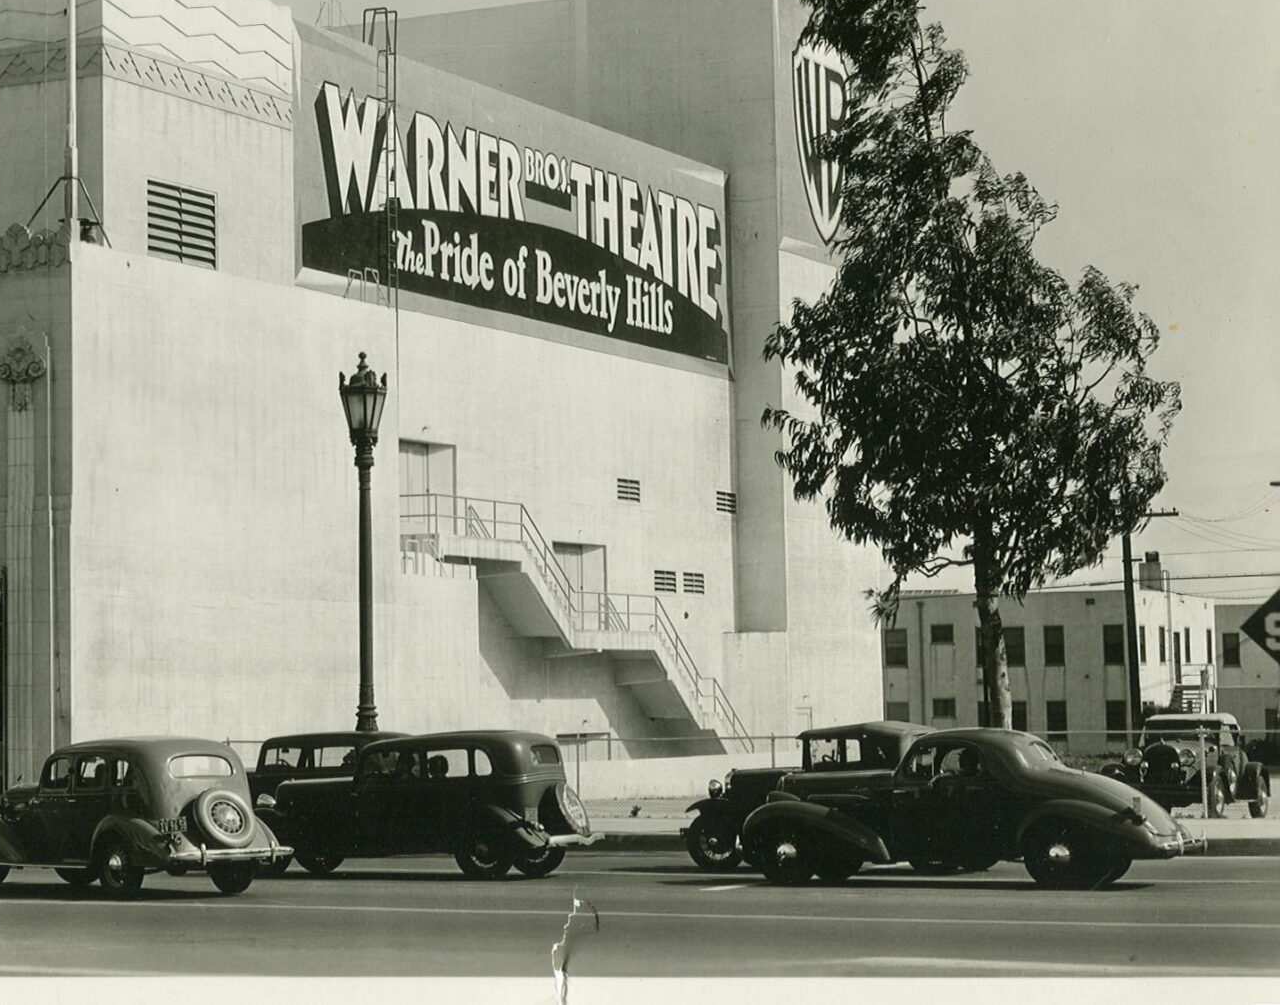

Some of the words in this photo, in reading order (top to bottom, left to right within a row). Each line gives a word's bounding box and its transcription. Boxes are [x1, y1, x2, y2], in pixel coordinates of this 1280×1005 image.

[318, 80, 525, 222] WARNER
[524, 146, 571, 194] BROS.
[570, 160, 719, 321] THEATRE
[393, 230, 425, 275] The
[421, 219, 495, 291] Pride
[503, 245, 528, 299] of
[535, 248, 621, 334] Beverly
[625, 274, 674, 335] Hills
